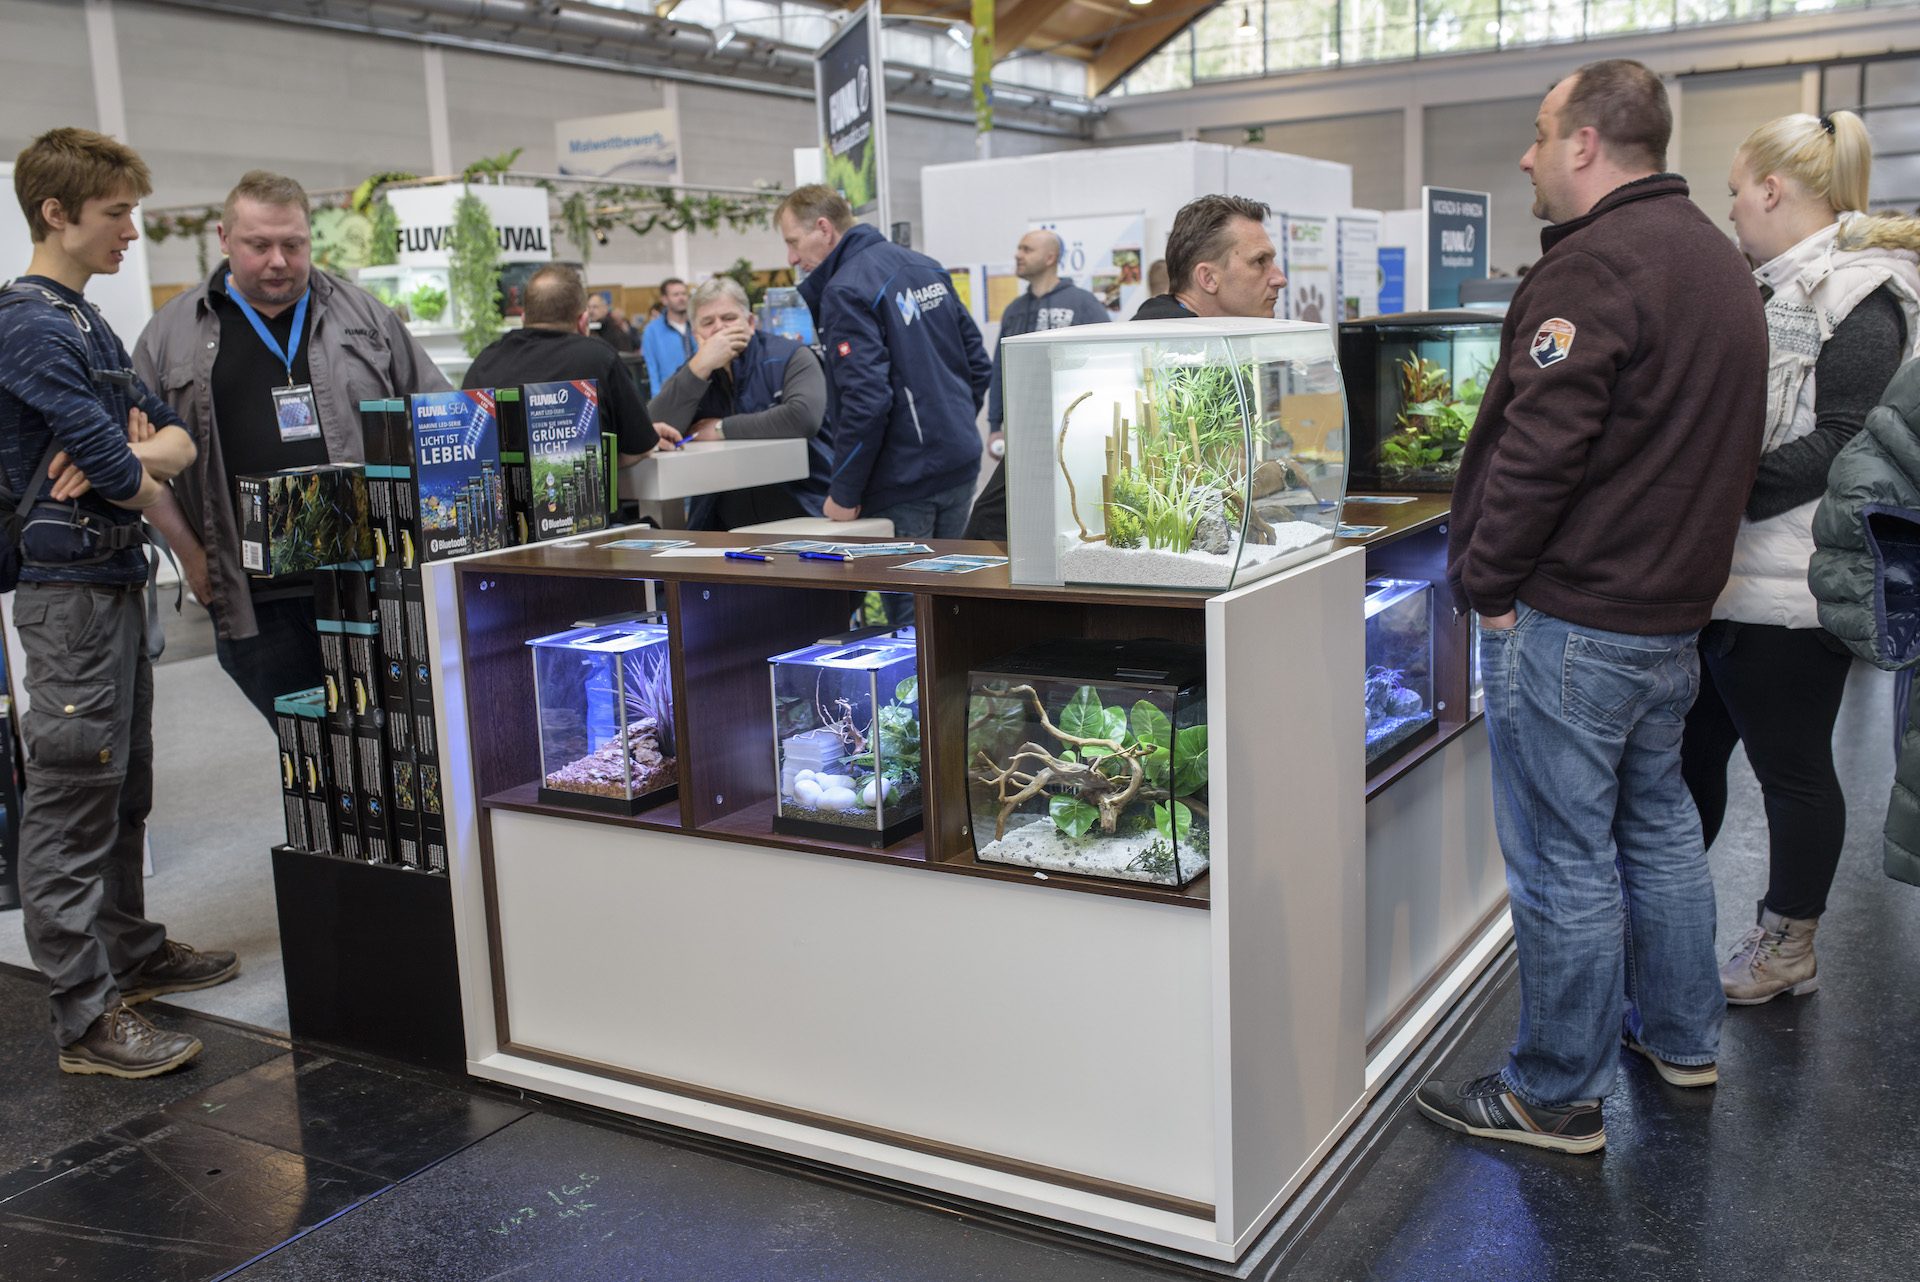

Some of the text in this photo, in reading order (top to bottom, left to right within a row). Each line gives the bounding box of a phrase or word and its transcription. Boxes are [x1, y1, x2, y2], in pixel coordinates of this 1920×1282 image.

[529, 393, 559, 407] FLUVAL
[417, 402, 469, 418] FLUVAL SEA
[418, 422, 438, 430] MARINE
[532, 424, 577, 442] GRÜNES
[420, 434, 459, 447] LICHT IST
[533, 440, 568, 456] LICHT
[421, 444, 476, 465] LEBEN
